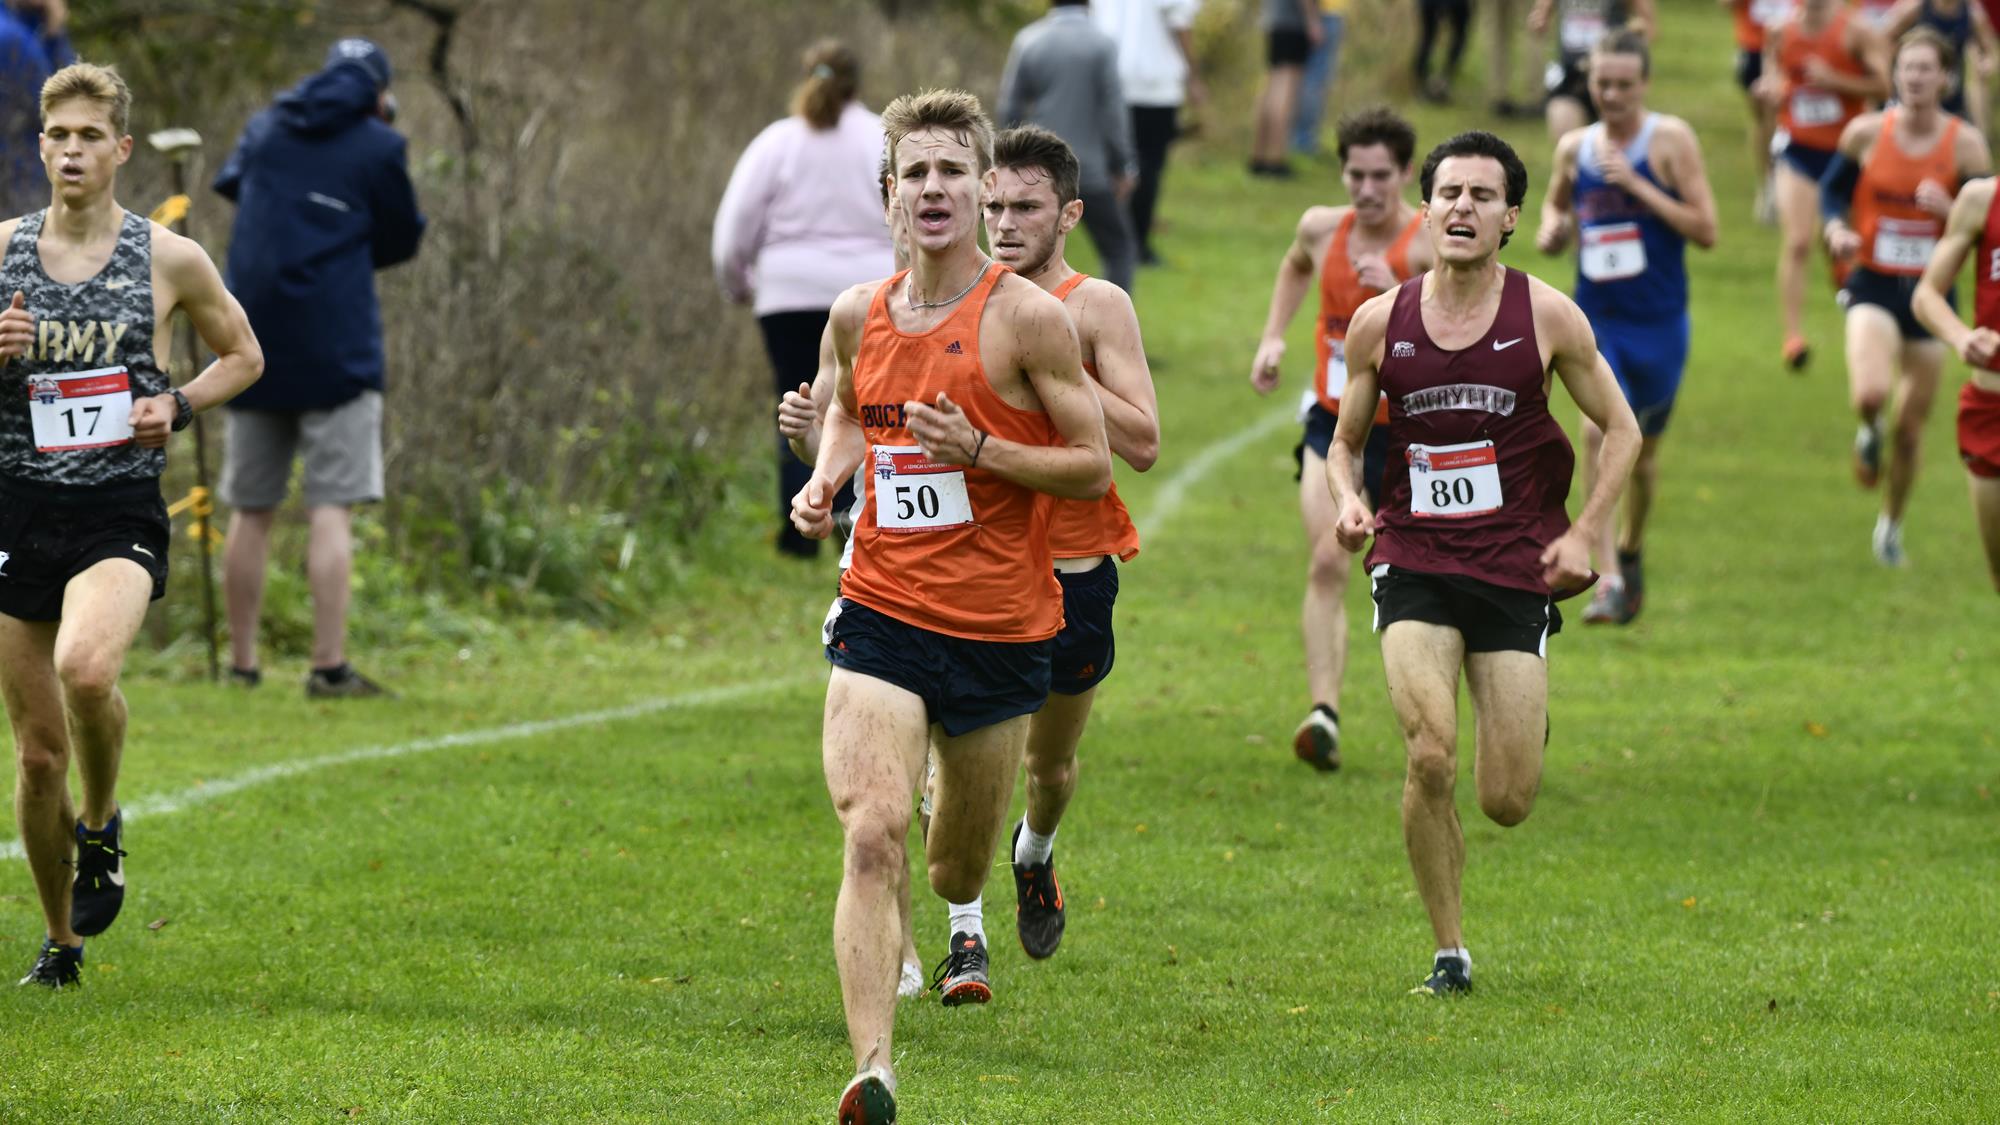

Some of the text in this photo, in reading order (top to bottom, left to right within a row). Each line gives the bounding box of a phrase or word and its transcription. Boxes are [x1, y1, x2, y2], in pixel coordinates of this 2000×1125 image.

[60, 405, 102, 438] 17
[895, 485, 940, 520] 50
[1431, 477, 1474, 508] 80
